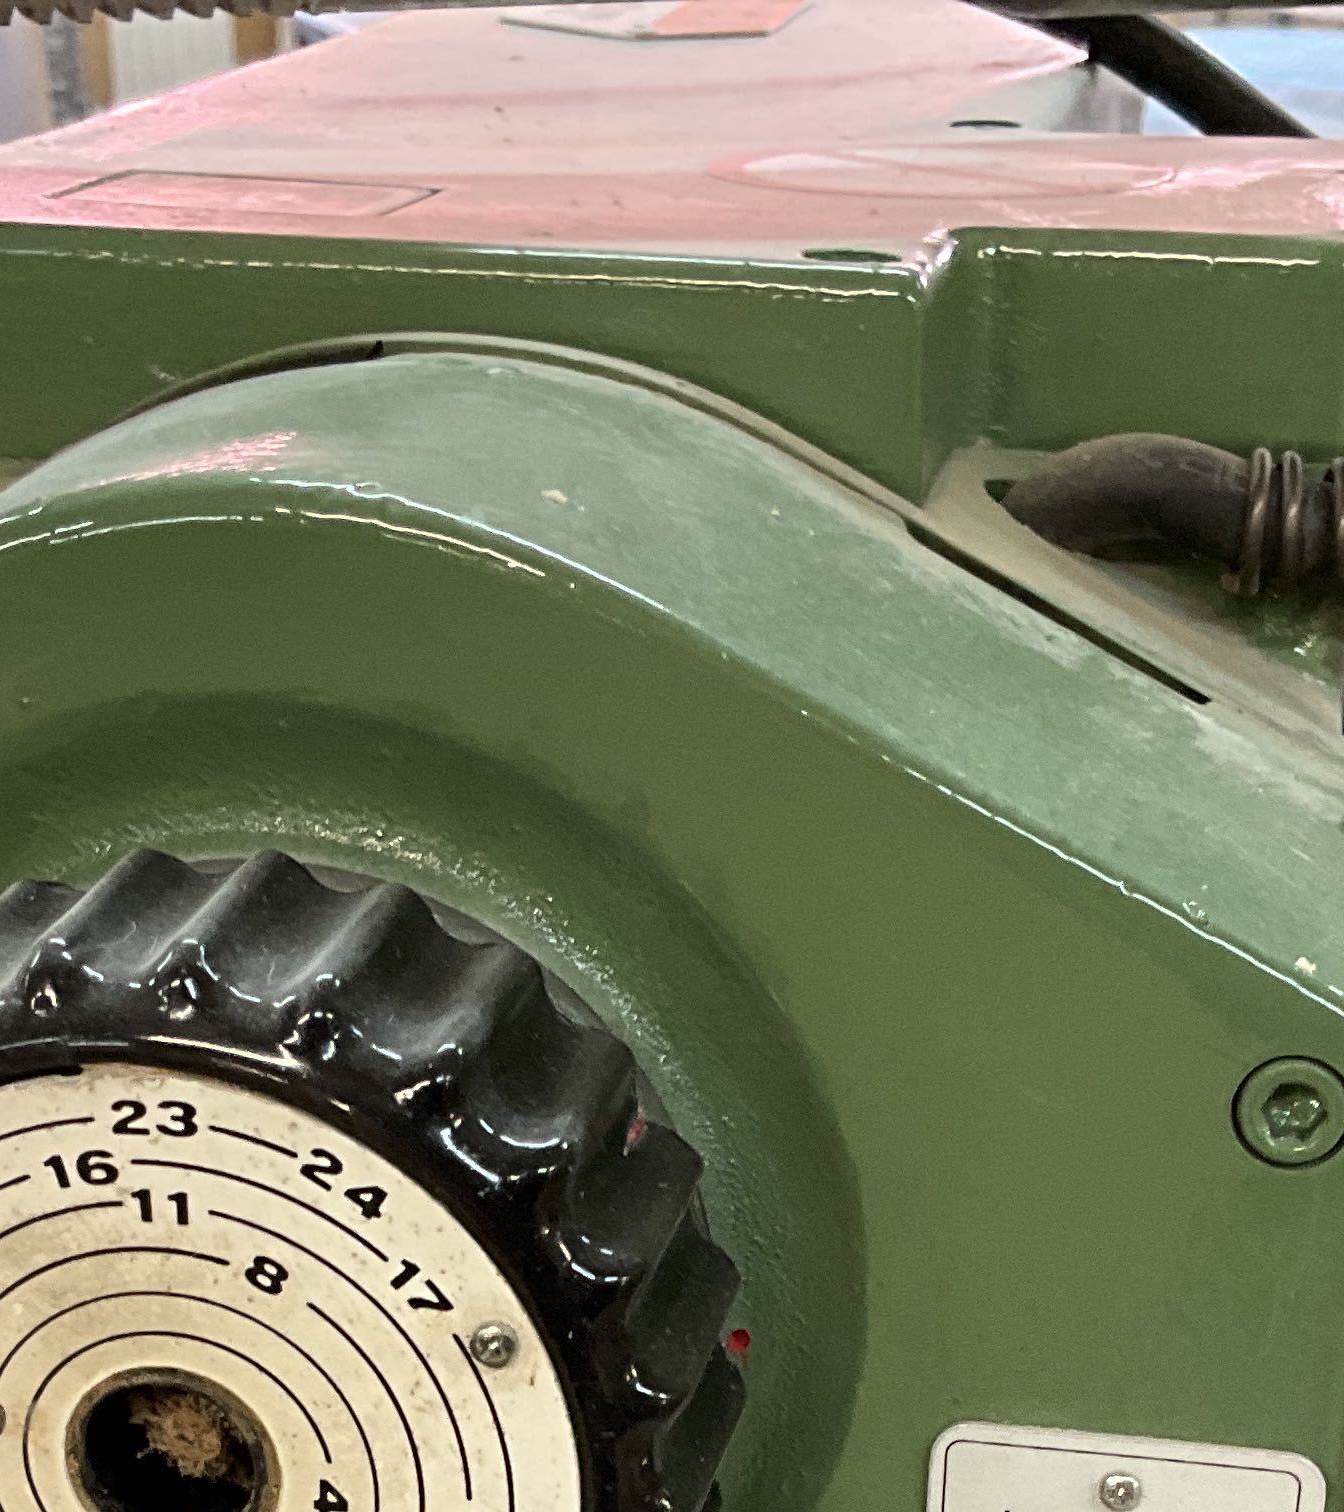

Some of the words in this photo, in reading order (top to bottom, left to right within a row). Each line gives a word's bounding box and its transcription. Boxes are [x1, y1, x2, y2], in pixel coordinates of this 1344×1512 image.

[110, 1099, 199, 1138] 23
[42, 1149, 120, 1190] 16
[299, 1147, 389, 1221] 24
[129, 1188, 190, 1227] 11
[244, 1255, 290, 1296] 8
[389, 1258, 455, 1313] 17
